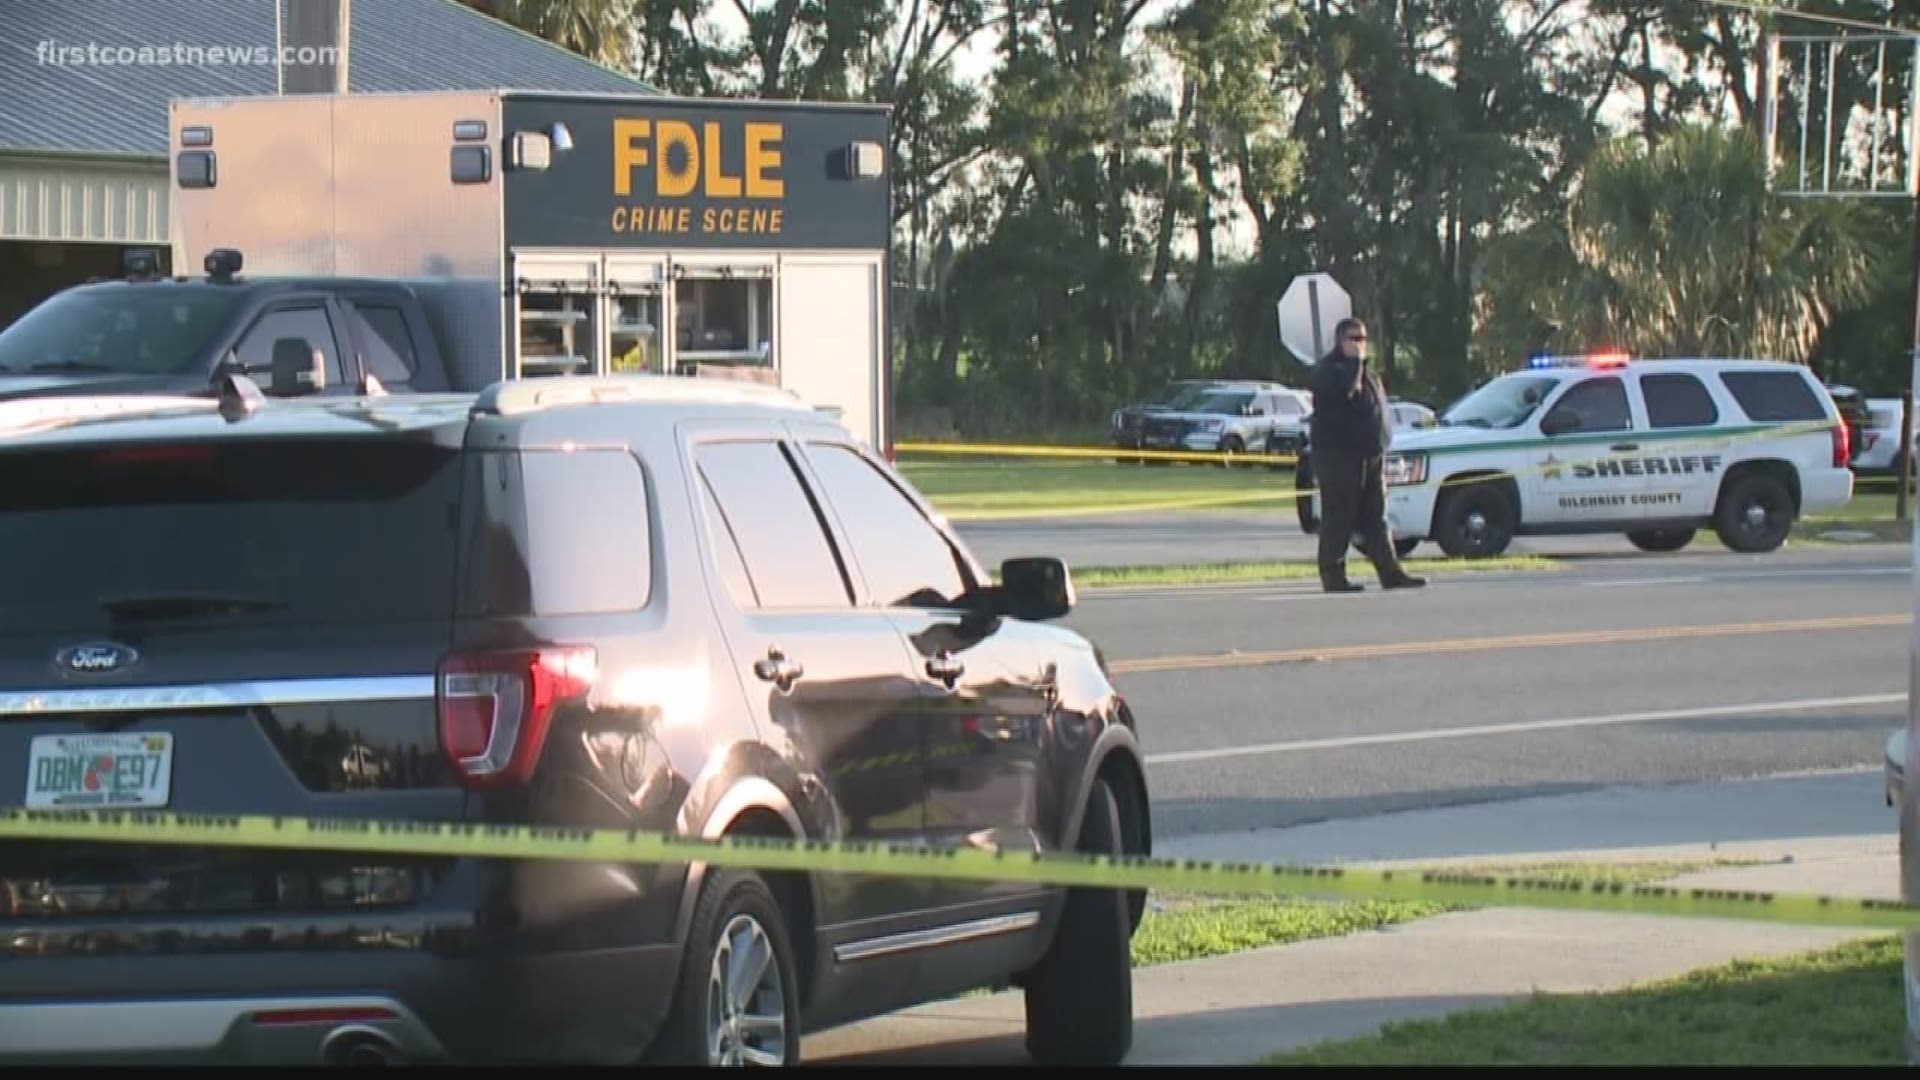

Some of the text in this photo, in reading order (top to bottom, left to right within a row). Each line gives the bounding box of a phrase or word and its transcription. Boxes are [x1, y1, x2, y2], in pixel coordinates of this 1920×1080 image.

[613, 118, 785, 198] FDLE
[612, 206, 784, 234] CRIME SCENE
[1572, 456, 1722, 478] SHERIFF
[1558, 492, 1683, 508] GILCHRIST COUNTY
[71, 648, 120, 668] Ford
